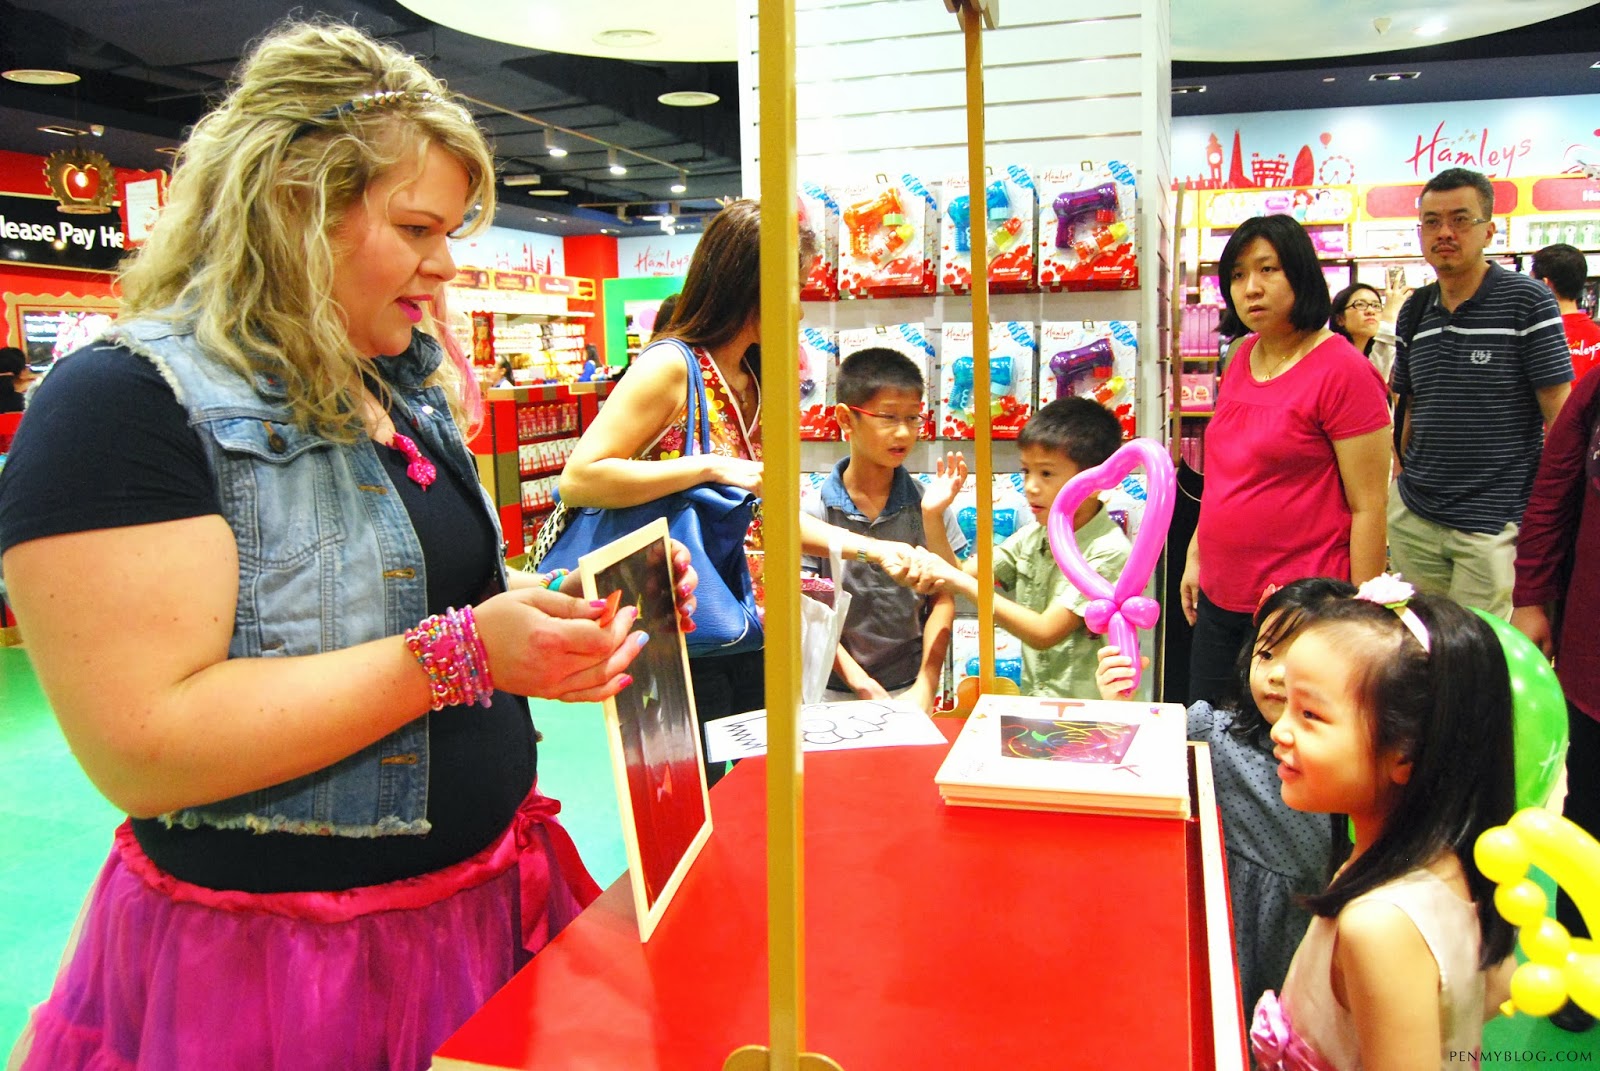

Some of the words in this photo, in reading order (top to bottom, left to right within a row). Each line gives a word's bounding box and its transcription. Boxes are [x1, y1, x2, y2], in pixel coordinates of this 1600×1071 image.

[1405, 120, 1532, 177] Hamleys
[1044, 168, 1074, 182] Hamleys
[0, 214, 56, 242] lease
[60, 222, 95, 250] Pay
[101, 225, 125, 248] He
[634, 240, 689, 273] Hamleys
[957, 624, 979, 637] Hamle
